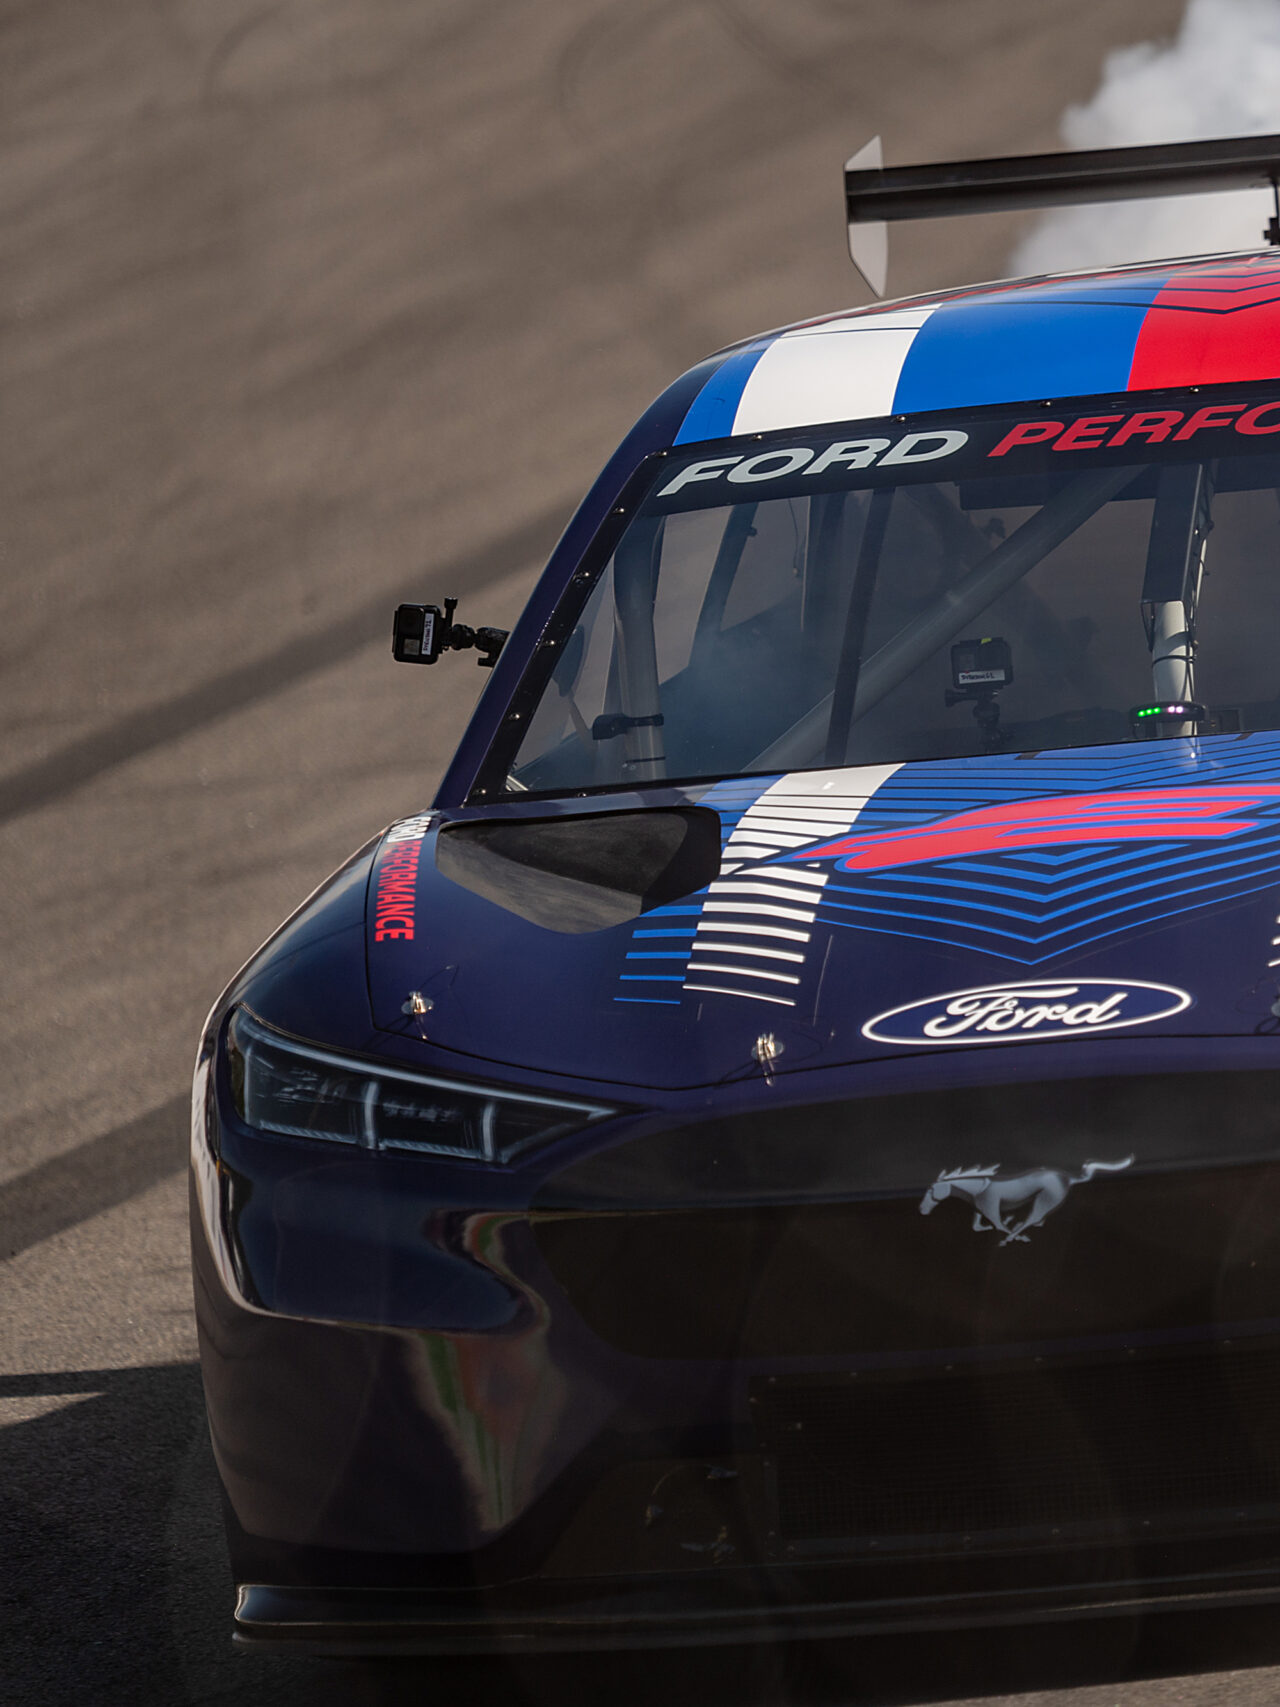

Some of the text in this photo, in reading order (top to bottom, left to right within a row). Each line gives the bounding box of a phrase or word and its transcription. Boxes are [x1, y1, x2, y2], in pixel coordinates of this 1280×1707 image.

[657, 429, 968, 496] FORD
[375, 816, 432, 943] FORD PERFORMANCE
[923, 986, 1129, 1038] Ford
